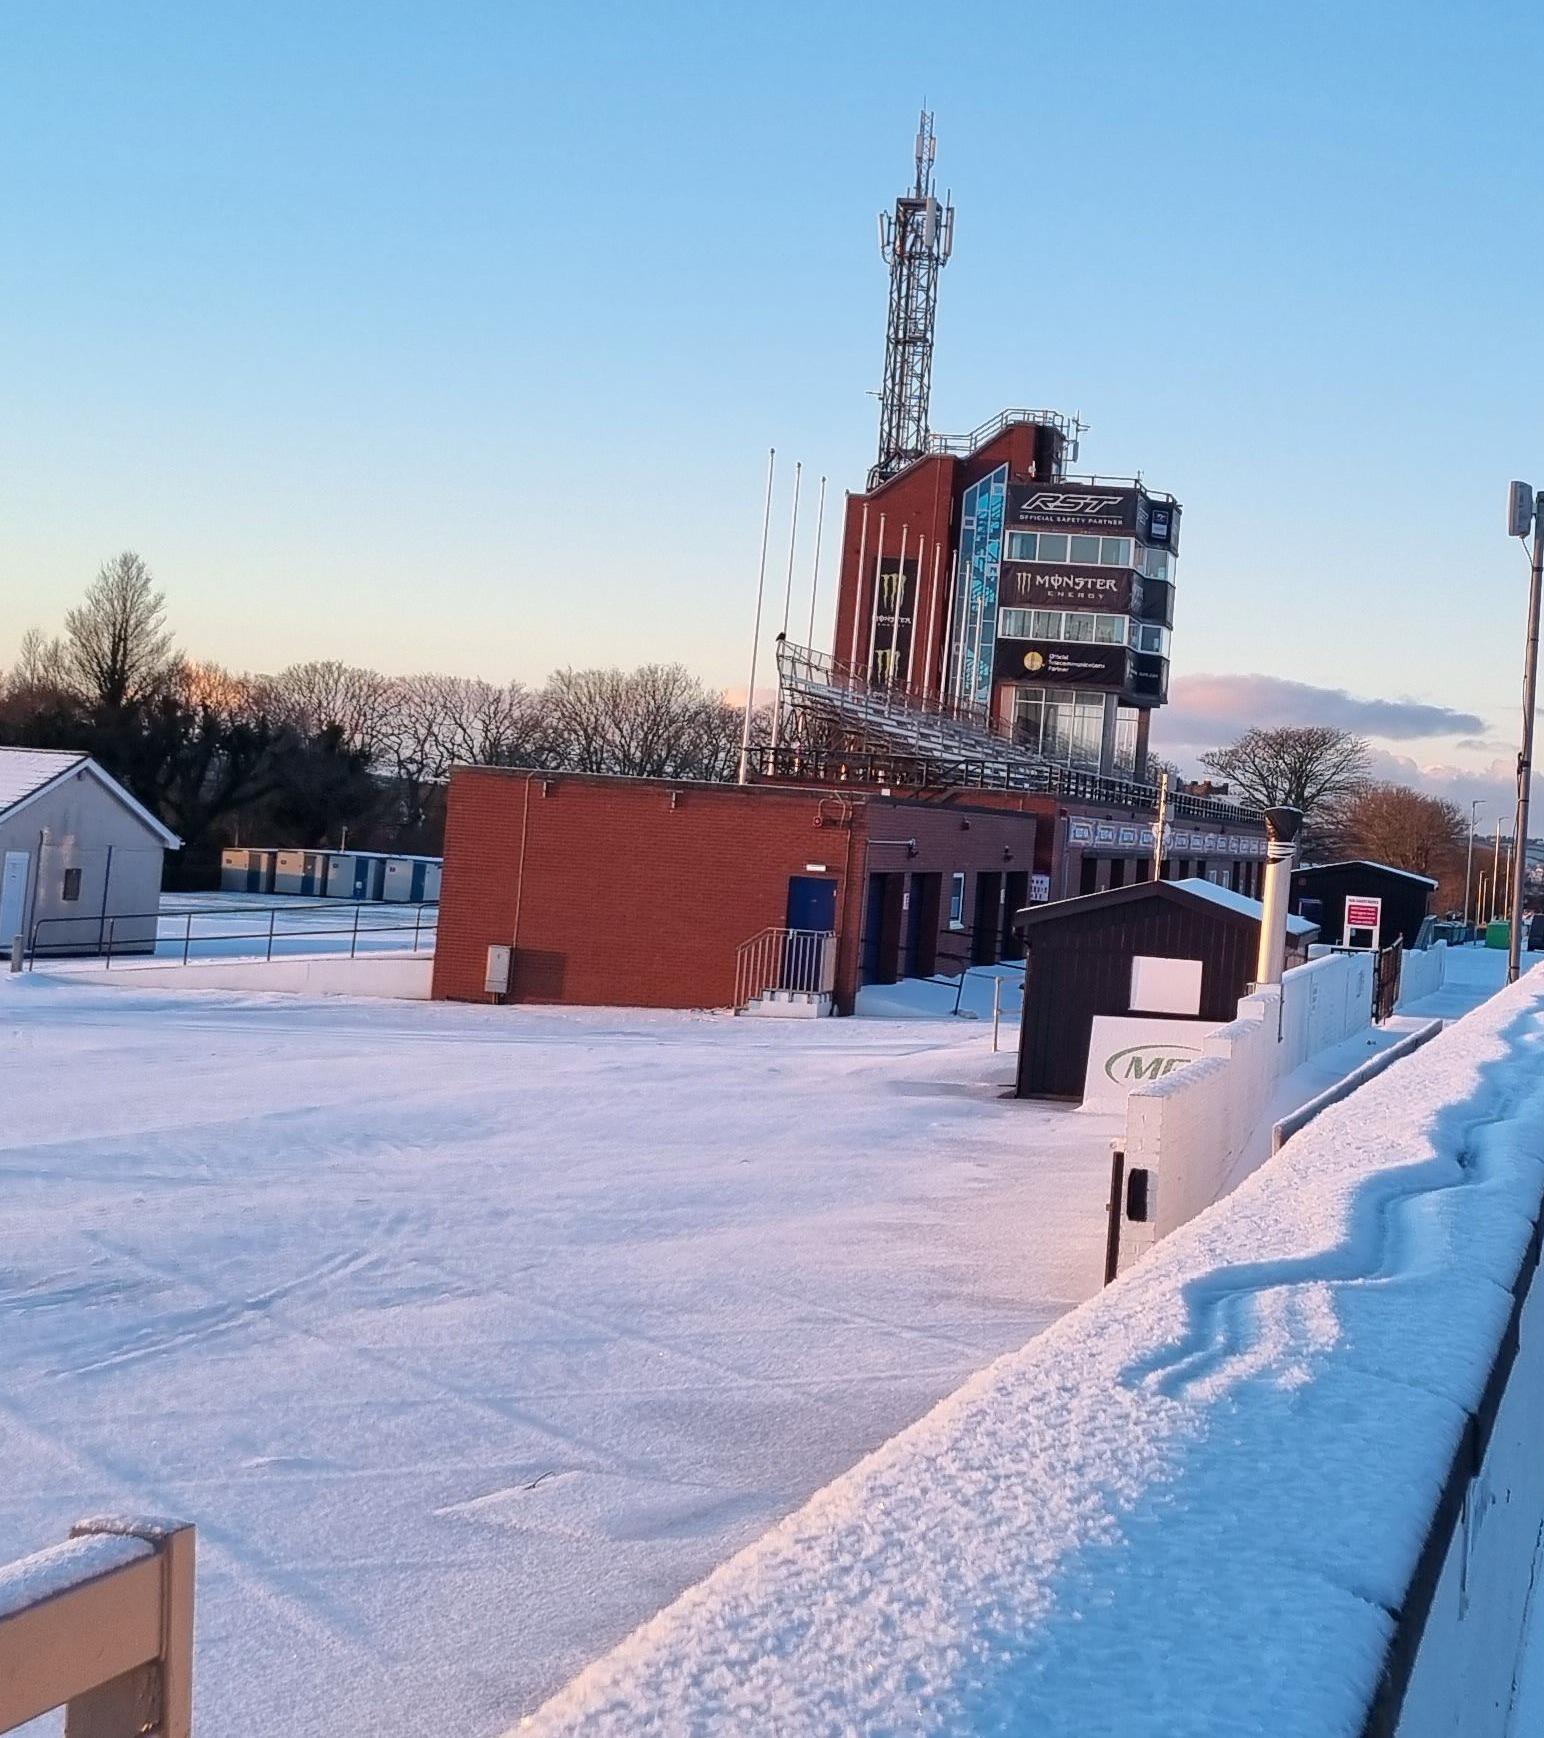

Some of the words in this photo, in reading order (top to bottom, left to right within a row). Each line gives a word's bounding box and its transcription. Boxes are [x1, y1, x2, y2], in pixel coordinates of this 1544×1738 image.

[1021, 492, 1124, 513] RST
[1019, 514, 1053, 522] OFFICIAL
[1088, 518, 1123, 526] PARTNER
[1035, 574, 1118, 592] MONSTER
[1047, 591, 1105, 599] ENERGY
